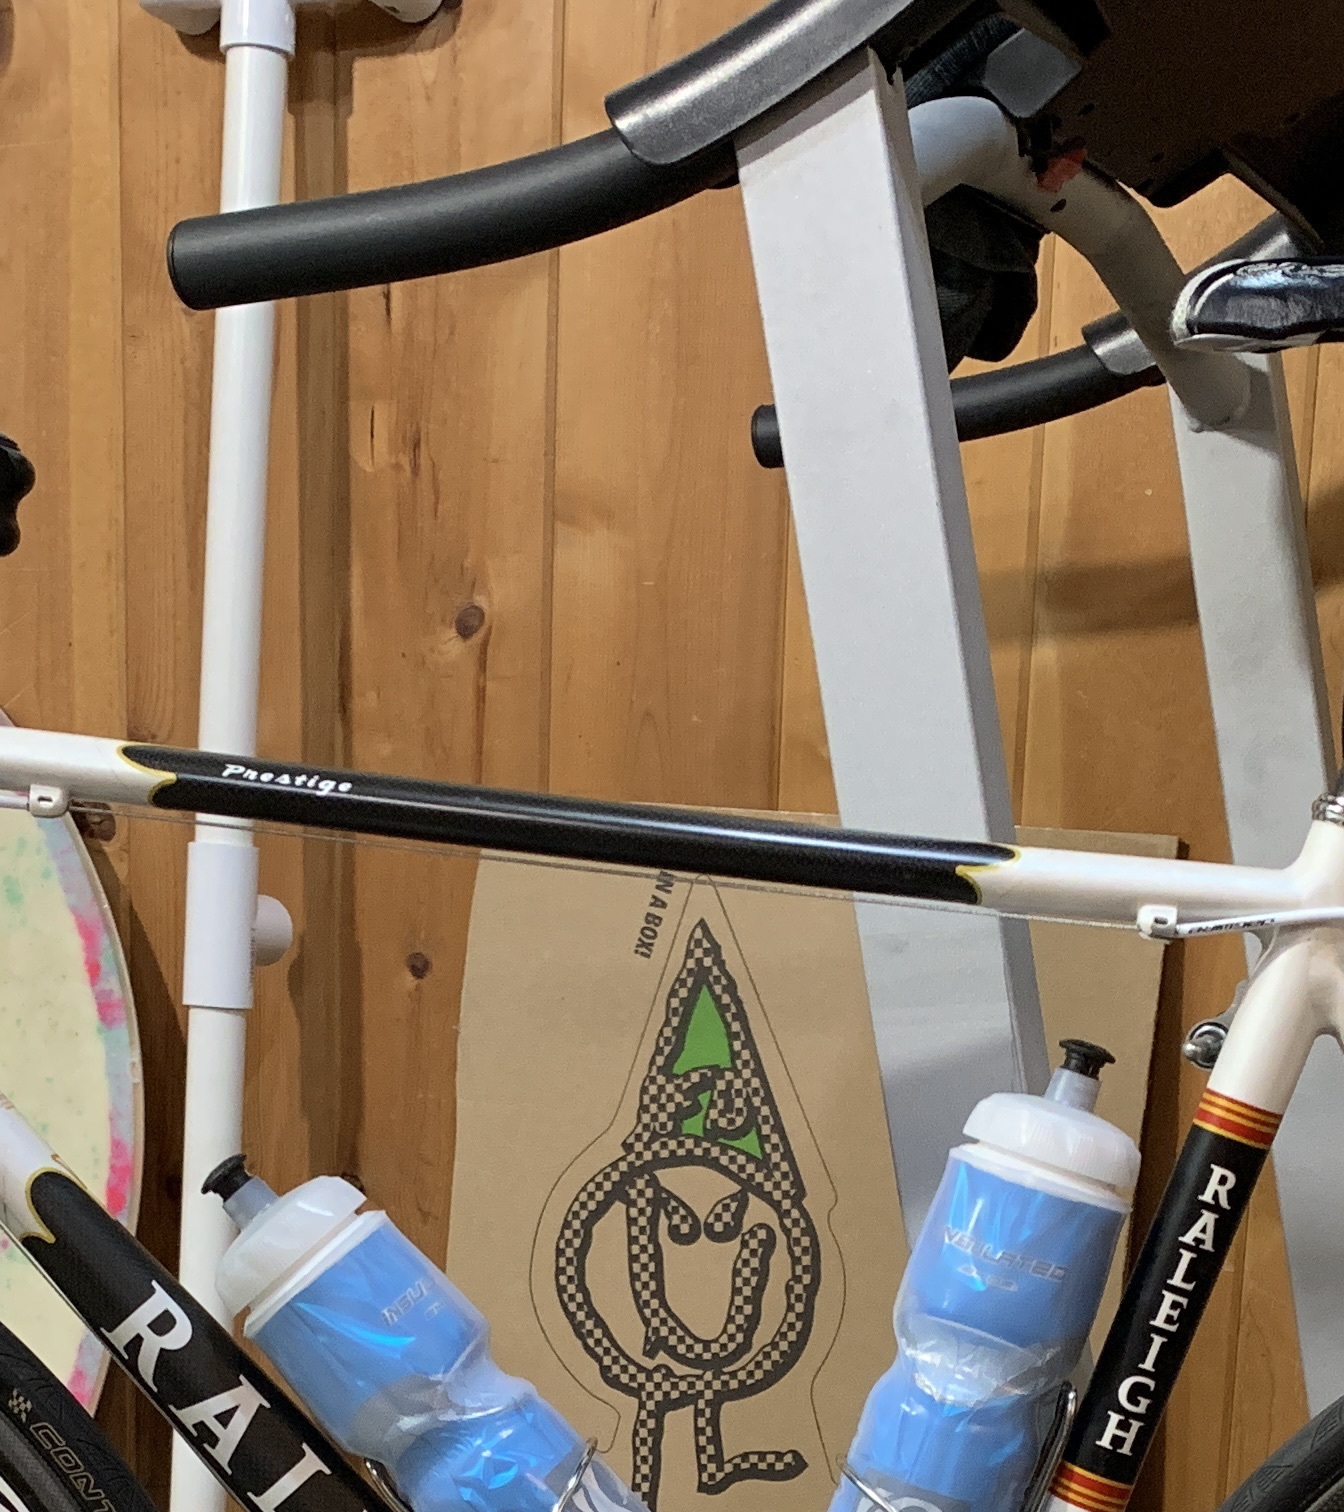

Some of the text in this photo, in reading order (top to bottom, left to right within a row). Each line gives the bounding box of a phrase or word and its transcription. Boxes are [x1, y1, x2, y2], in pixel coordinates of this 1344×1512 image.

[220, 762, 353, 797] Prestige
[648, 894, 668, 909] A
[633, 912, 663, 959] BOX!
[1095, 1163, 1238, 1457] RALEIGH
